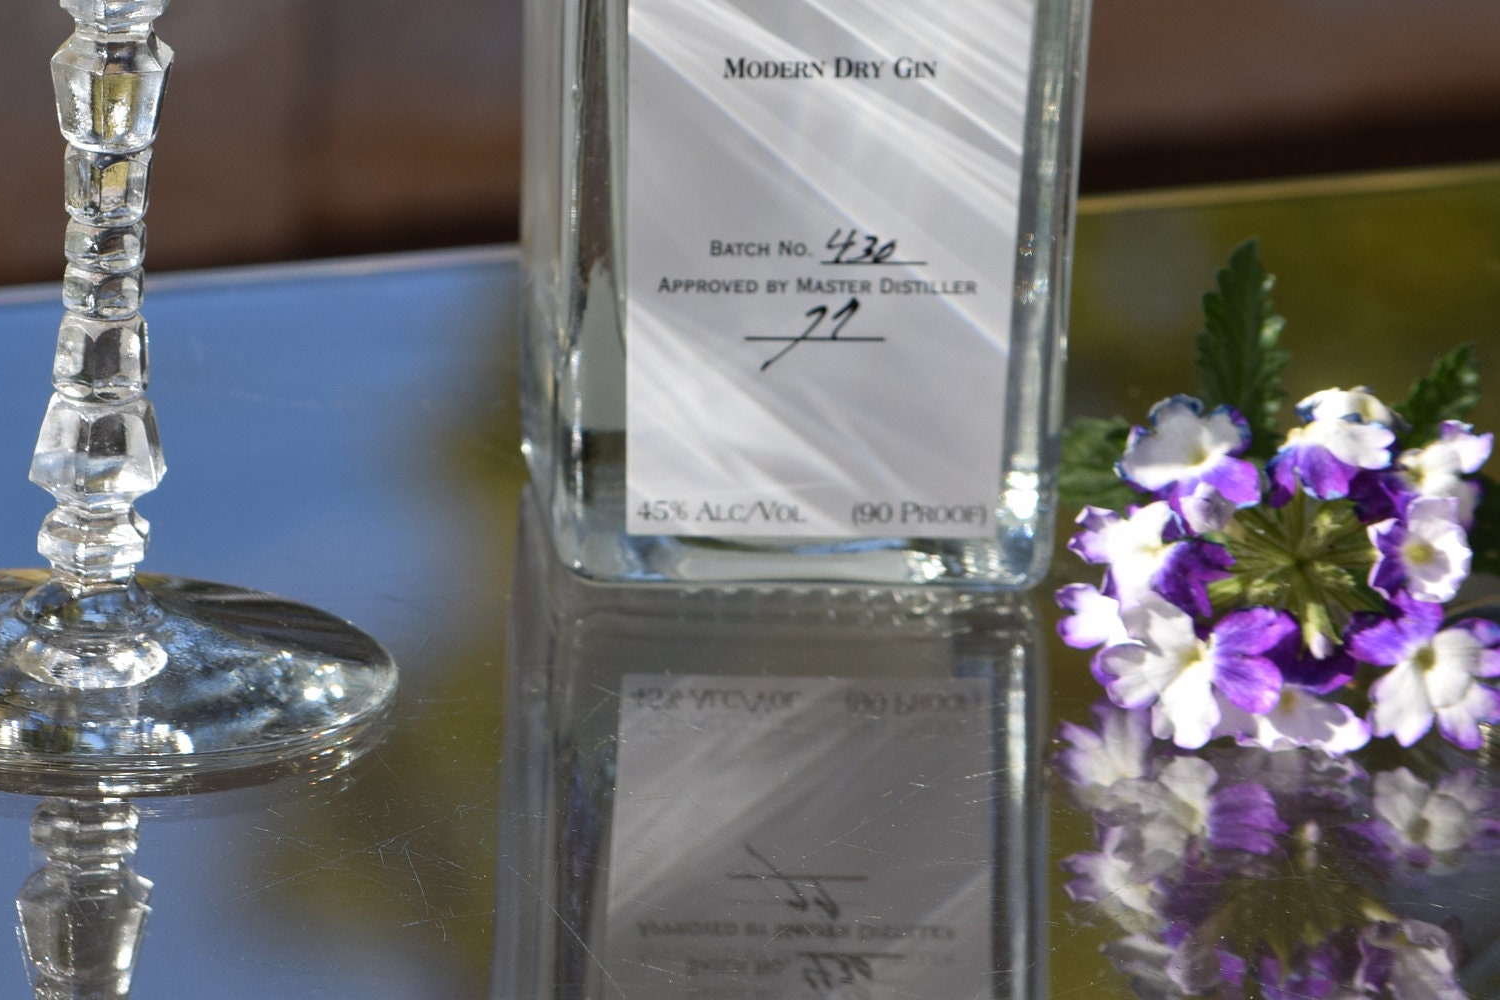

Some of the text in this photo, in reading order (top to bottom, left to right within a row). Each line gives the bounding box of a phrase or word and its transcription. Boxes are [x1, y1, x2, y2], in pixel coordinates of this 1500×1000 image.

[723, 57, 937, 79] MODERN DRY GIN
[709, 239, 771, 257] BATCH
[778, 240, 813, 257] NO.
[657, 277, 978, 295] APPROVED BY MASTER DISTILLER
[635, 500, 688, 524] 45%
[851, 501, 988, 525] (90 PROOF)
